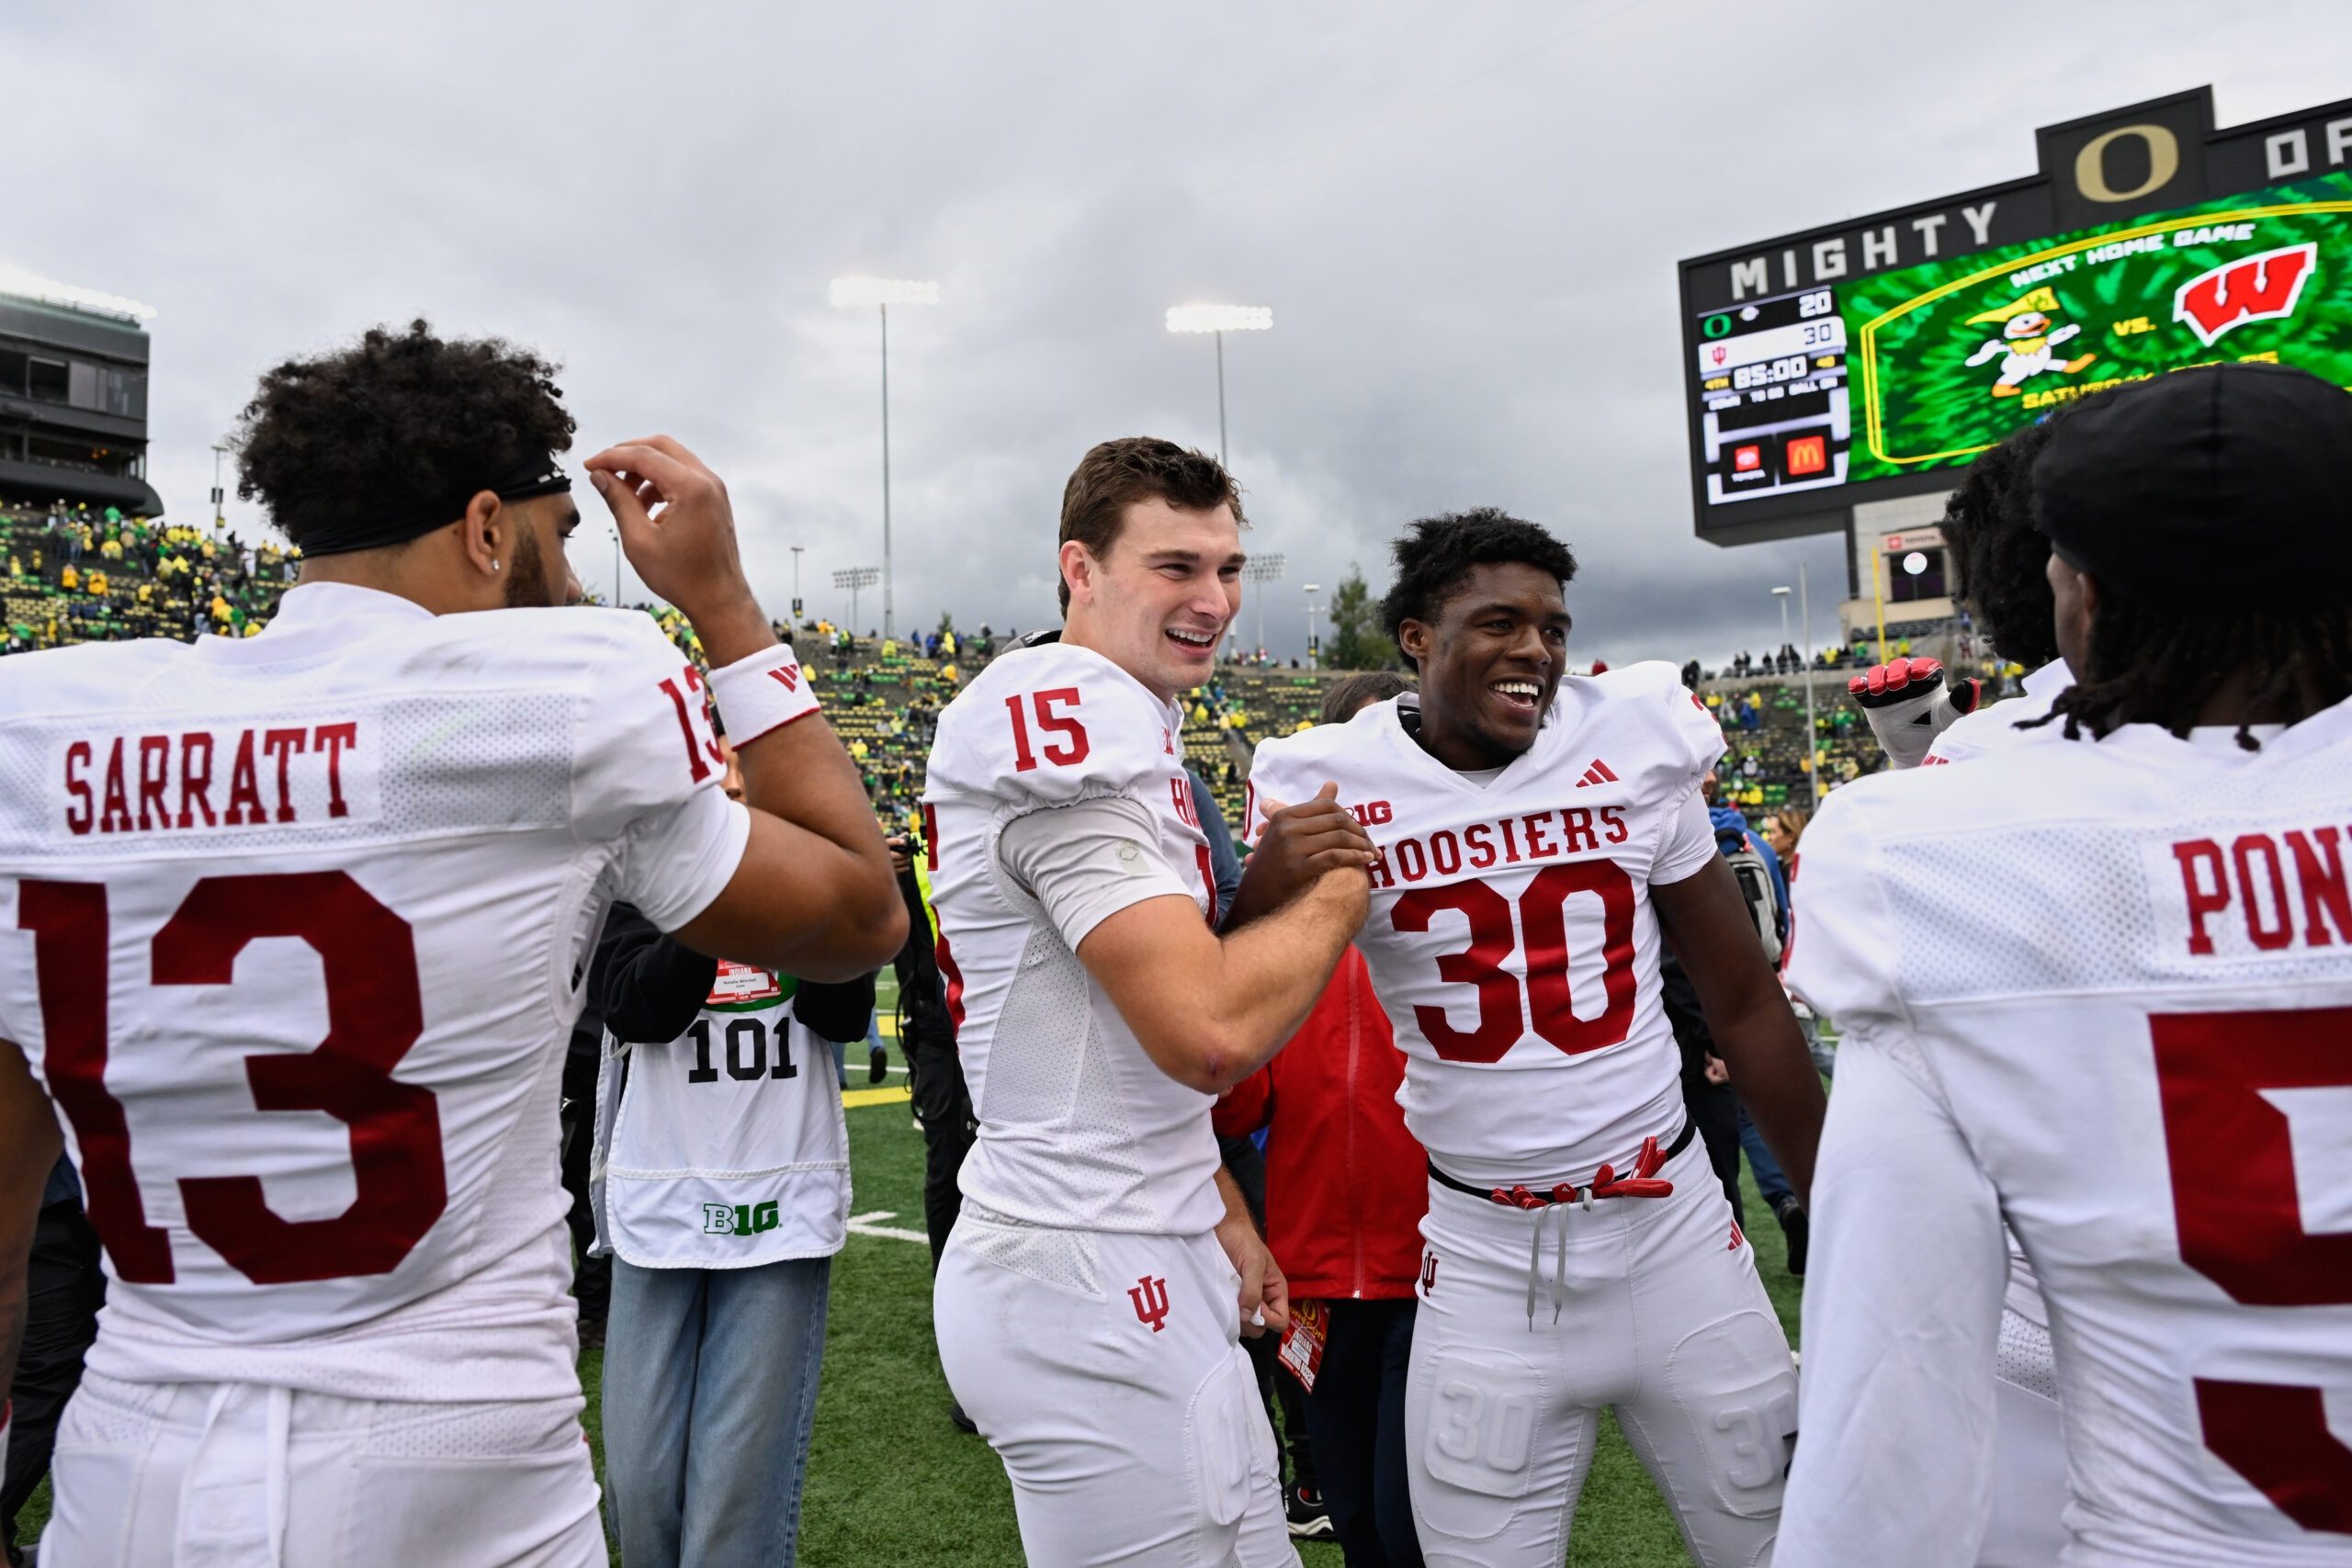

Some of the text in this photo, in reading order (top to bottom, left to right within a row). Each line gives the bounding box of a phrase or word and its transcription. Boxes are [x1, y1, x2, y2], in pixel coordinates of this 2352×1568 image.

[2075, 124, 2179, 203] O
[1731, 201, 1997, 300] MIGHTY
[2010, 223, 2256, 288] NEXT HOME GAME
[1799, 290, 1832, 318] 20
[1804, 323, 1831, 345] 30
[2172, 242, 2317, 347] W
[1005, 687, 1090, 773] 15
[66, 722, 356, 835] SARRATT
[1365, 805, 1629, 889] HOOSIERS
[2172, 825, 2352, 956] PON
[1390, 859, 1636, 1064] 30
[17, 870, 447, 1284] 13
[687, 1017, 797, 1083] 101
